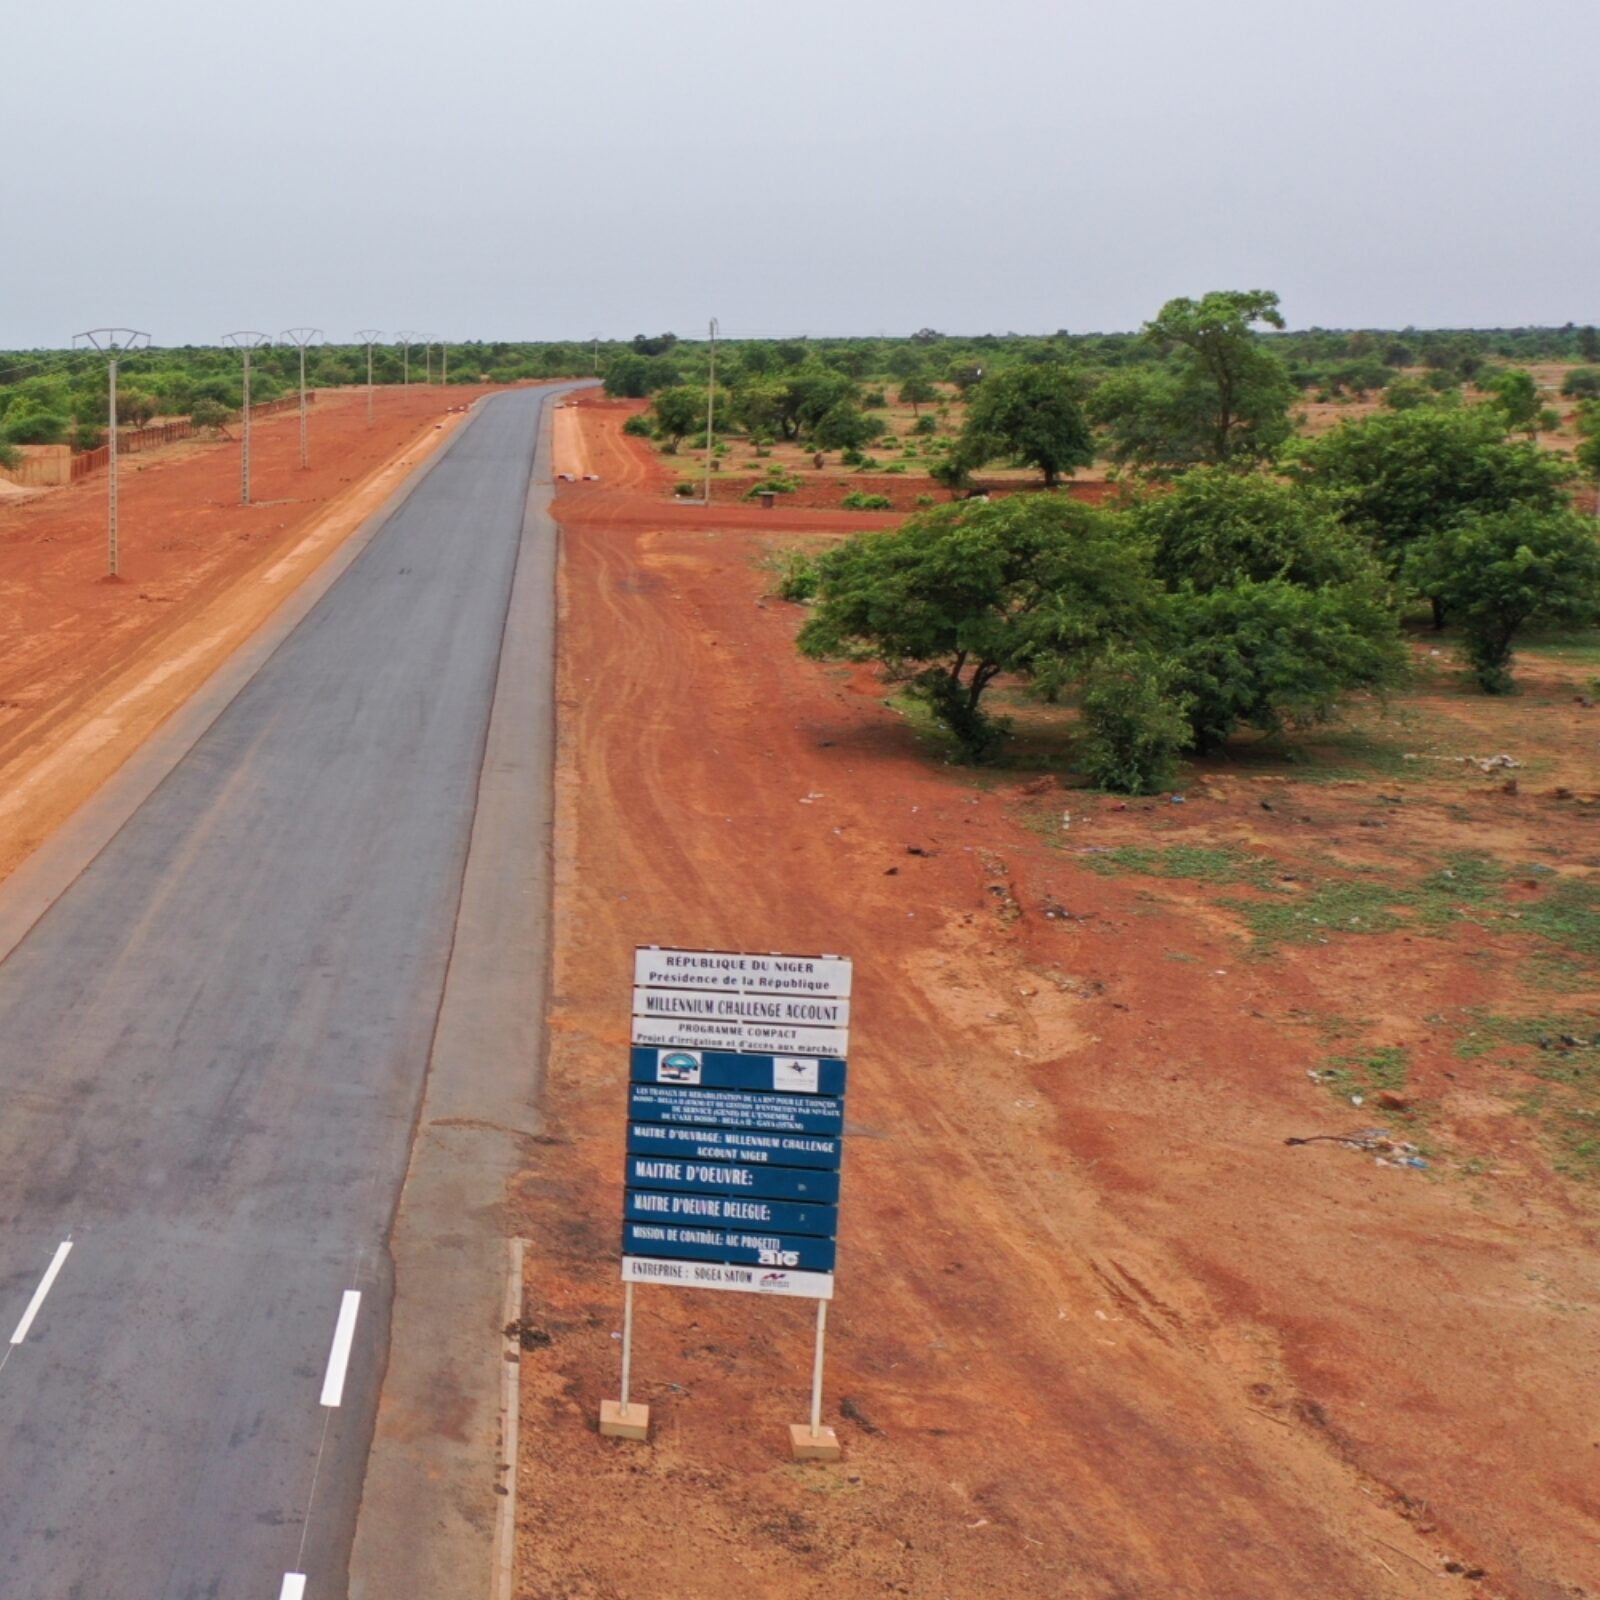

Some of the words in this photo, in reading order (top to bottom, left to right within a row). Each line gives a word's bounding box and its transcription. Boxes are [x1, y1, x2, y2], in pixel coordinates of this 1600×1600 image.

[752, 960, 768, 971] DU
[775, 962, 814, 973] NIGER
[649, 971, 718, 984] Présidence
[723, 976, 737, 985] de
[742, 976, 754, 985] la
[759, 977, 830, 991] République
[646, 996, 714, 1014] MILLENNIUM
[718, 1000, 782, 1017] CHALLENGE
[786, 1004, 839, 1021] ACCOUNT
[678, 1023, 742, 1036] PROGRAMME
[747, 1028, 796, 1039] COMPACT
[725, 1134, 780, 1148] MILLENNIUM
[782, 1139, 835, 1153] CHALLENGE
[697, 1146, 738, 1159] ACCOUNT
[740, 1150, 768, 1161] NIGER
[686, 1165, 753, 1186] D'OEUVRE:
[672, 1197, 720, 1217] D'OEUVRE
[632, 1226, 665, 1240] MISSION
[667, 1229, 677, 1242] DE
[741, 1235, 780, 1250] PROGETTI
[694, 1267, 722, 1281] SOGEA
[724, 1270, 753, 1284] SATOM
